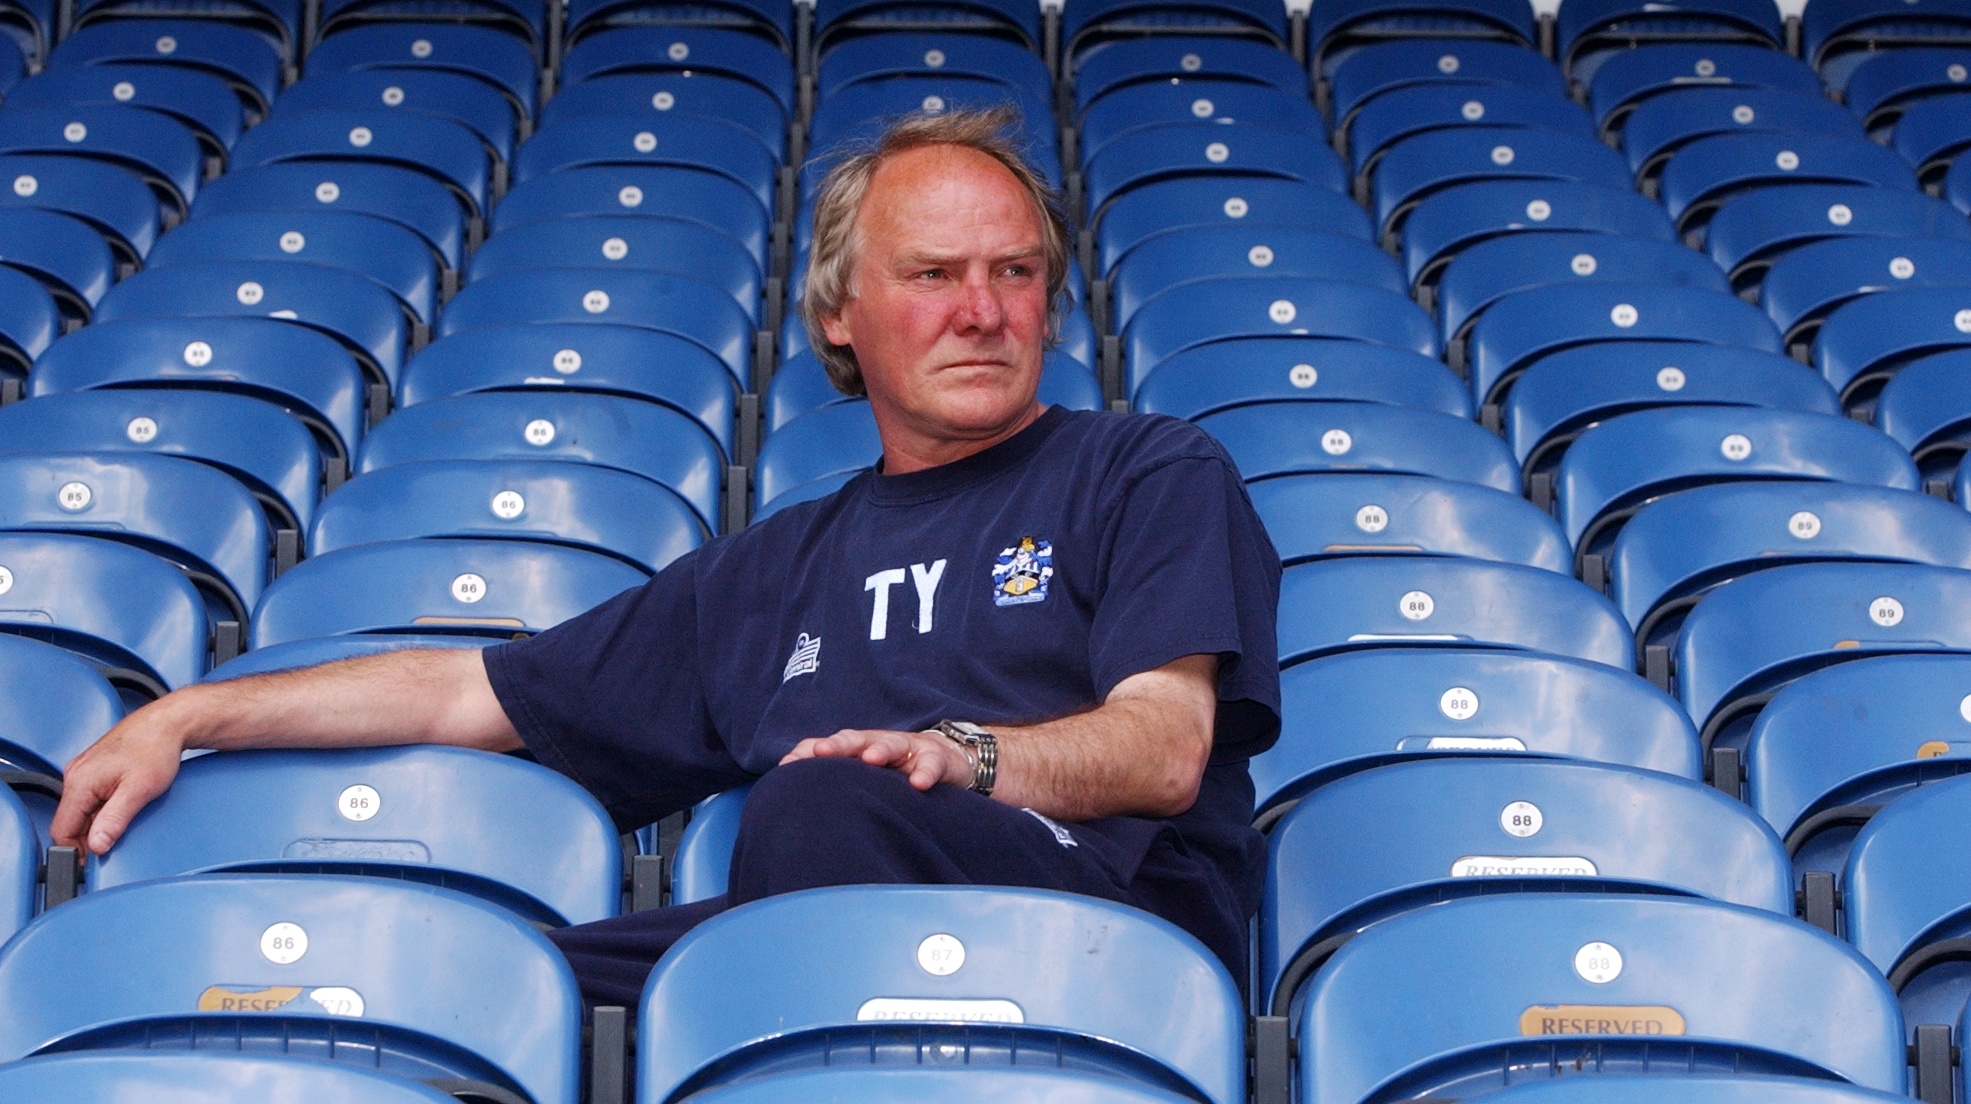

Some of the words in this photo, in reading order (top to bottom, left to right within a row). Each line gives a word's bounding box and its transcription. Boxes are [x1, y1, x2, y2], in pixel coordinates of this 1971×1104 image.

[136, 427, 150, 435] 85
[533, 428, 547, 436] 86
[1330, 438, 1344, 446] 88
[1730, 444, 1744, 452] 89
[67, 493, 82, 502] 85
[501, 501, 516, 509] 86
[1365, 515, 1380, 524] 88
[1798, 522, 1813, 531] 89
[461, 584, 477, 593] 86
[864, 559, 947, 640] TY
[1409, 602, 1425, 611] 88
[1878, 608, 1895, 618] 89
[1450, 699, 1469, 710] 88
[350, 797, 369, 809] 86
[1512, 815, 1532, 826] 88
[272, 937, 294, 950] 86
[931, 949, 953, 961] 87
[1588, 958, 1610, 970] 88
[1541, 1017, 1664, 1035] RESERVED
